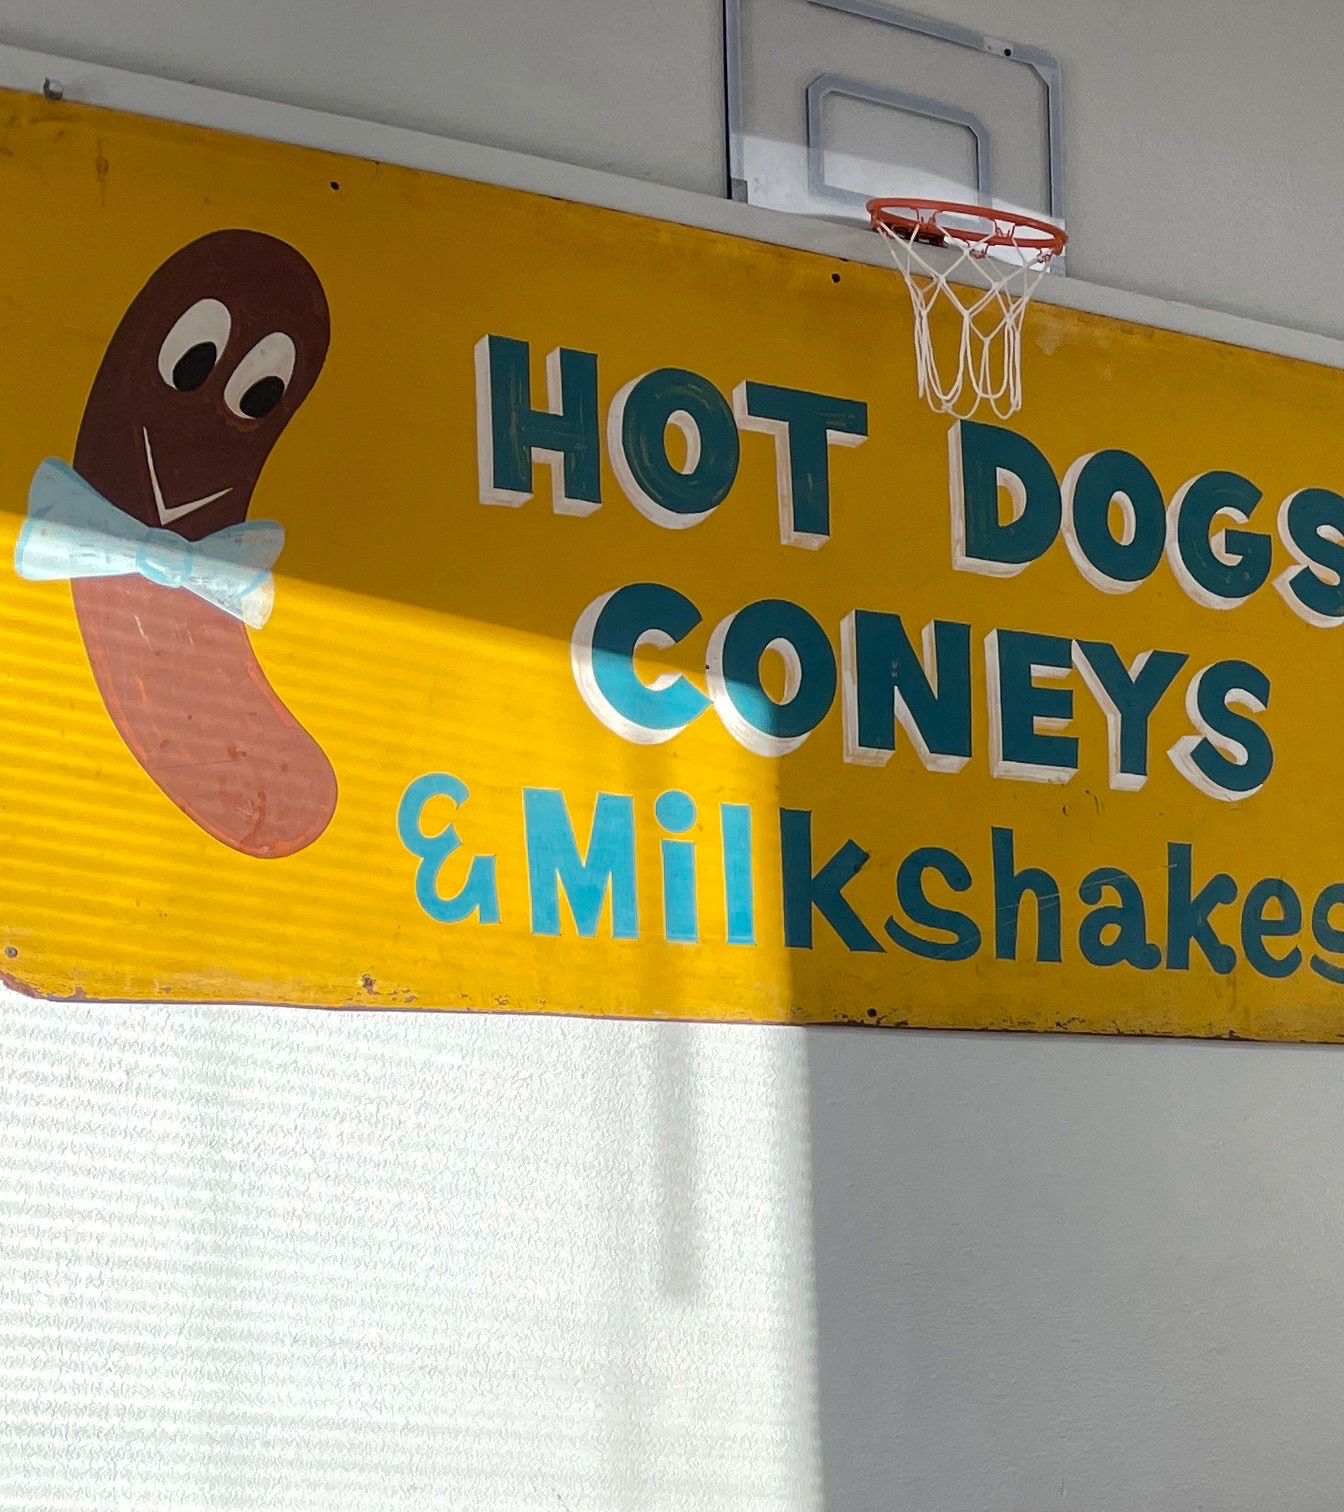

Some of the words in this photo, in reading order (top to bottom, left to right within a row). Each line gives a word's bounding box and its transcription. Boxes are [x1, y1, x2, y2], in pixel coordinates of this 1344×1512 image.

[474, 333, 868, 551] HOT
[570, 582, 1275, 802] CONEYS
[398, 771, 499, 926] &
